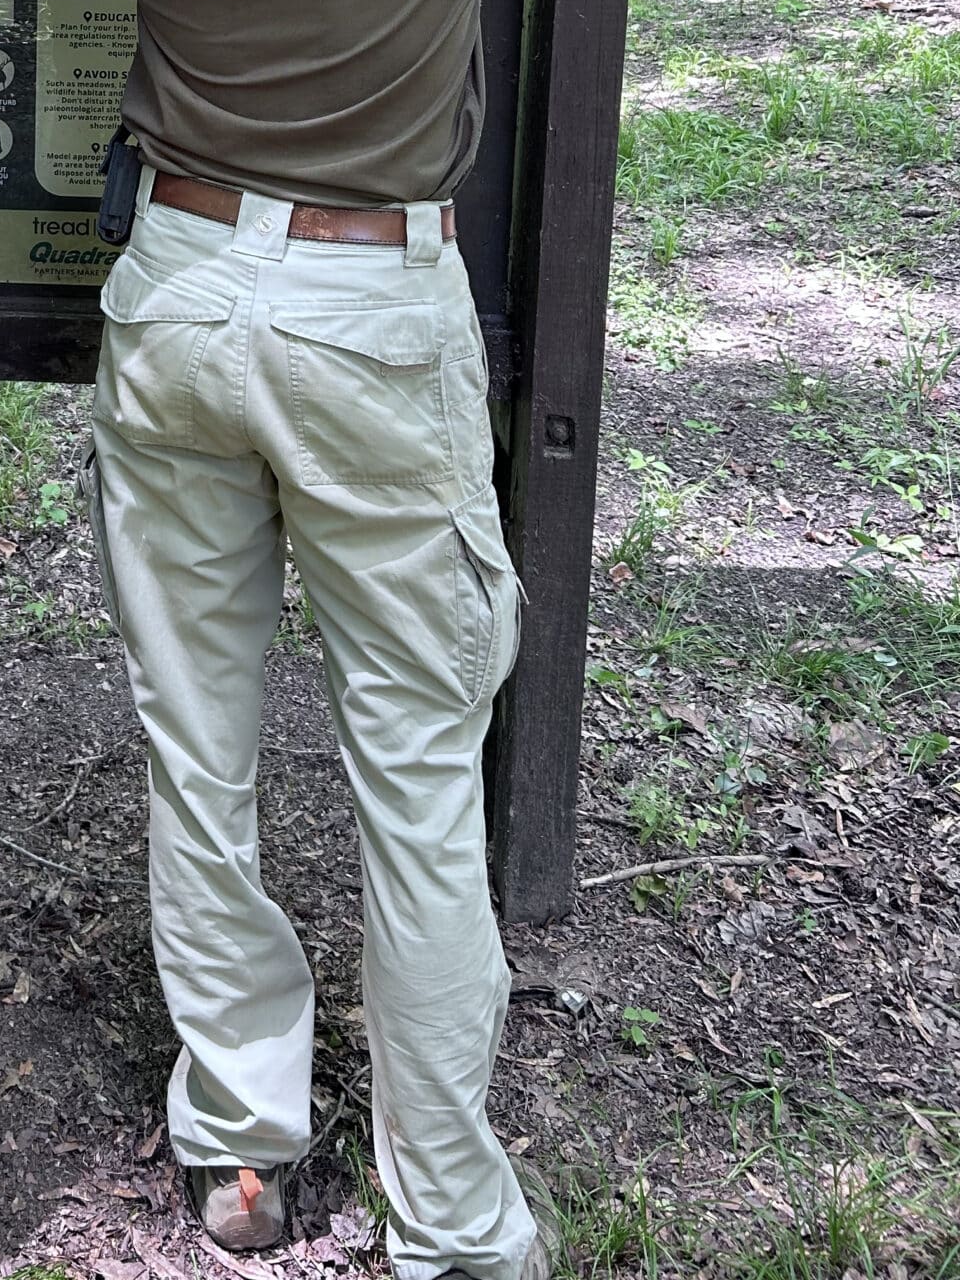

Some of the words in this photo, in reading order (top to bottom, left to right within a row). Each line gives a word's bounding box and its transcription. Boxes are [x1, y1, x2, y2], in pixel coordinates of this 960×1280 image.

[60, 23, 78, 31] Plan
[70, 32, 116, 40] regulations
[84, 70, 119, 79] AVOID
[46, 80, 65, 88] Such
[46, 88, 76, 96] wildlife
[77, 89, 106, 97] habitat
[44, 105, 105, 113] paleontological
[32, 217, 90, 236] tread
